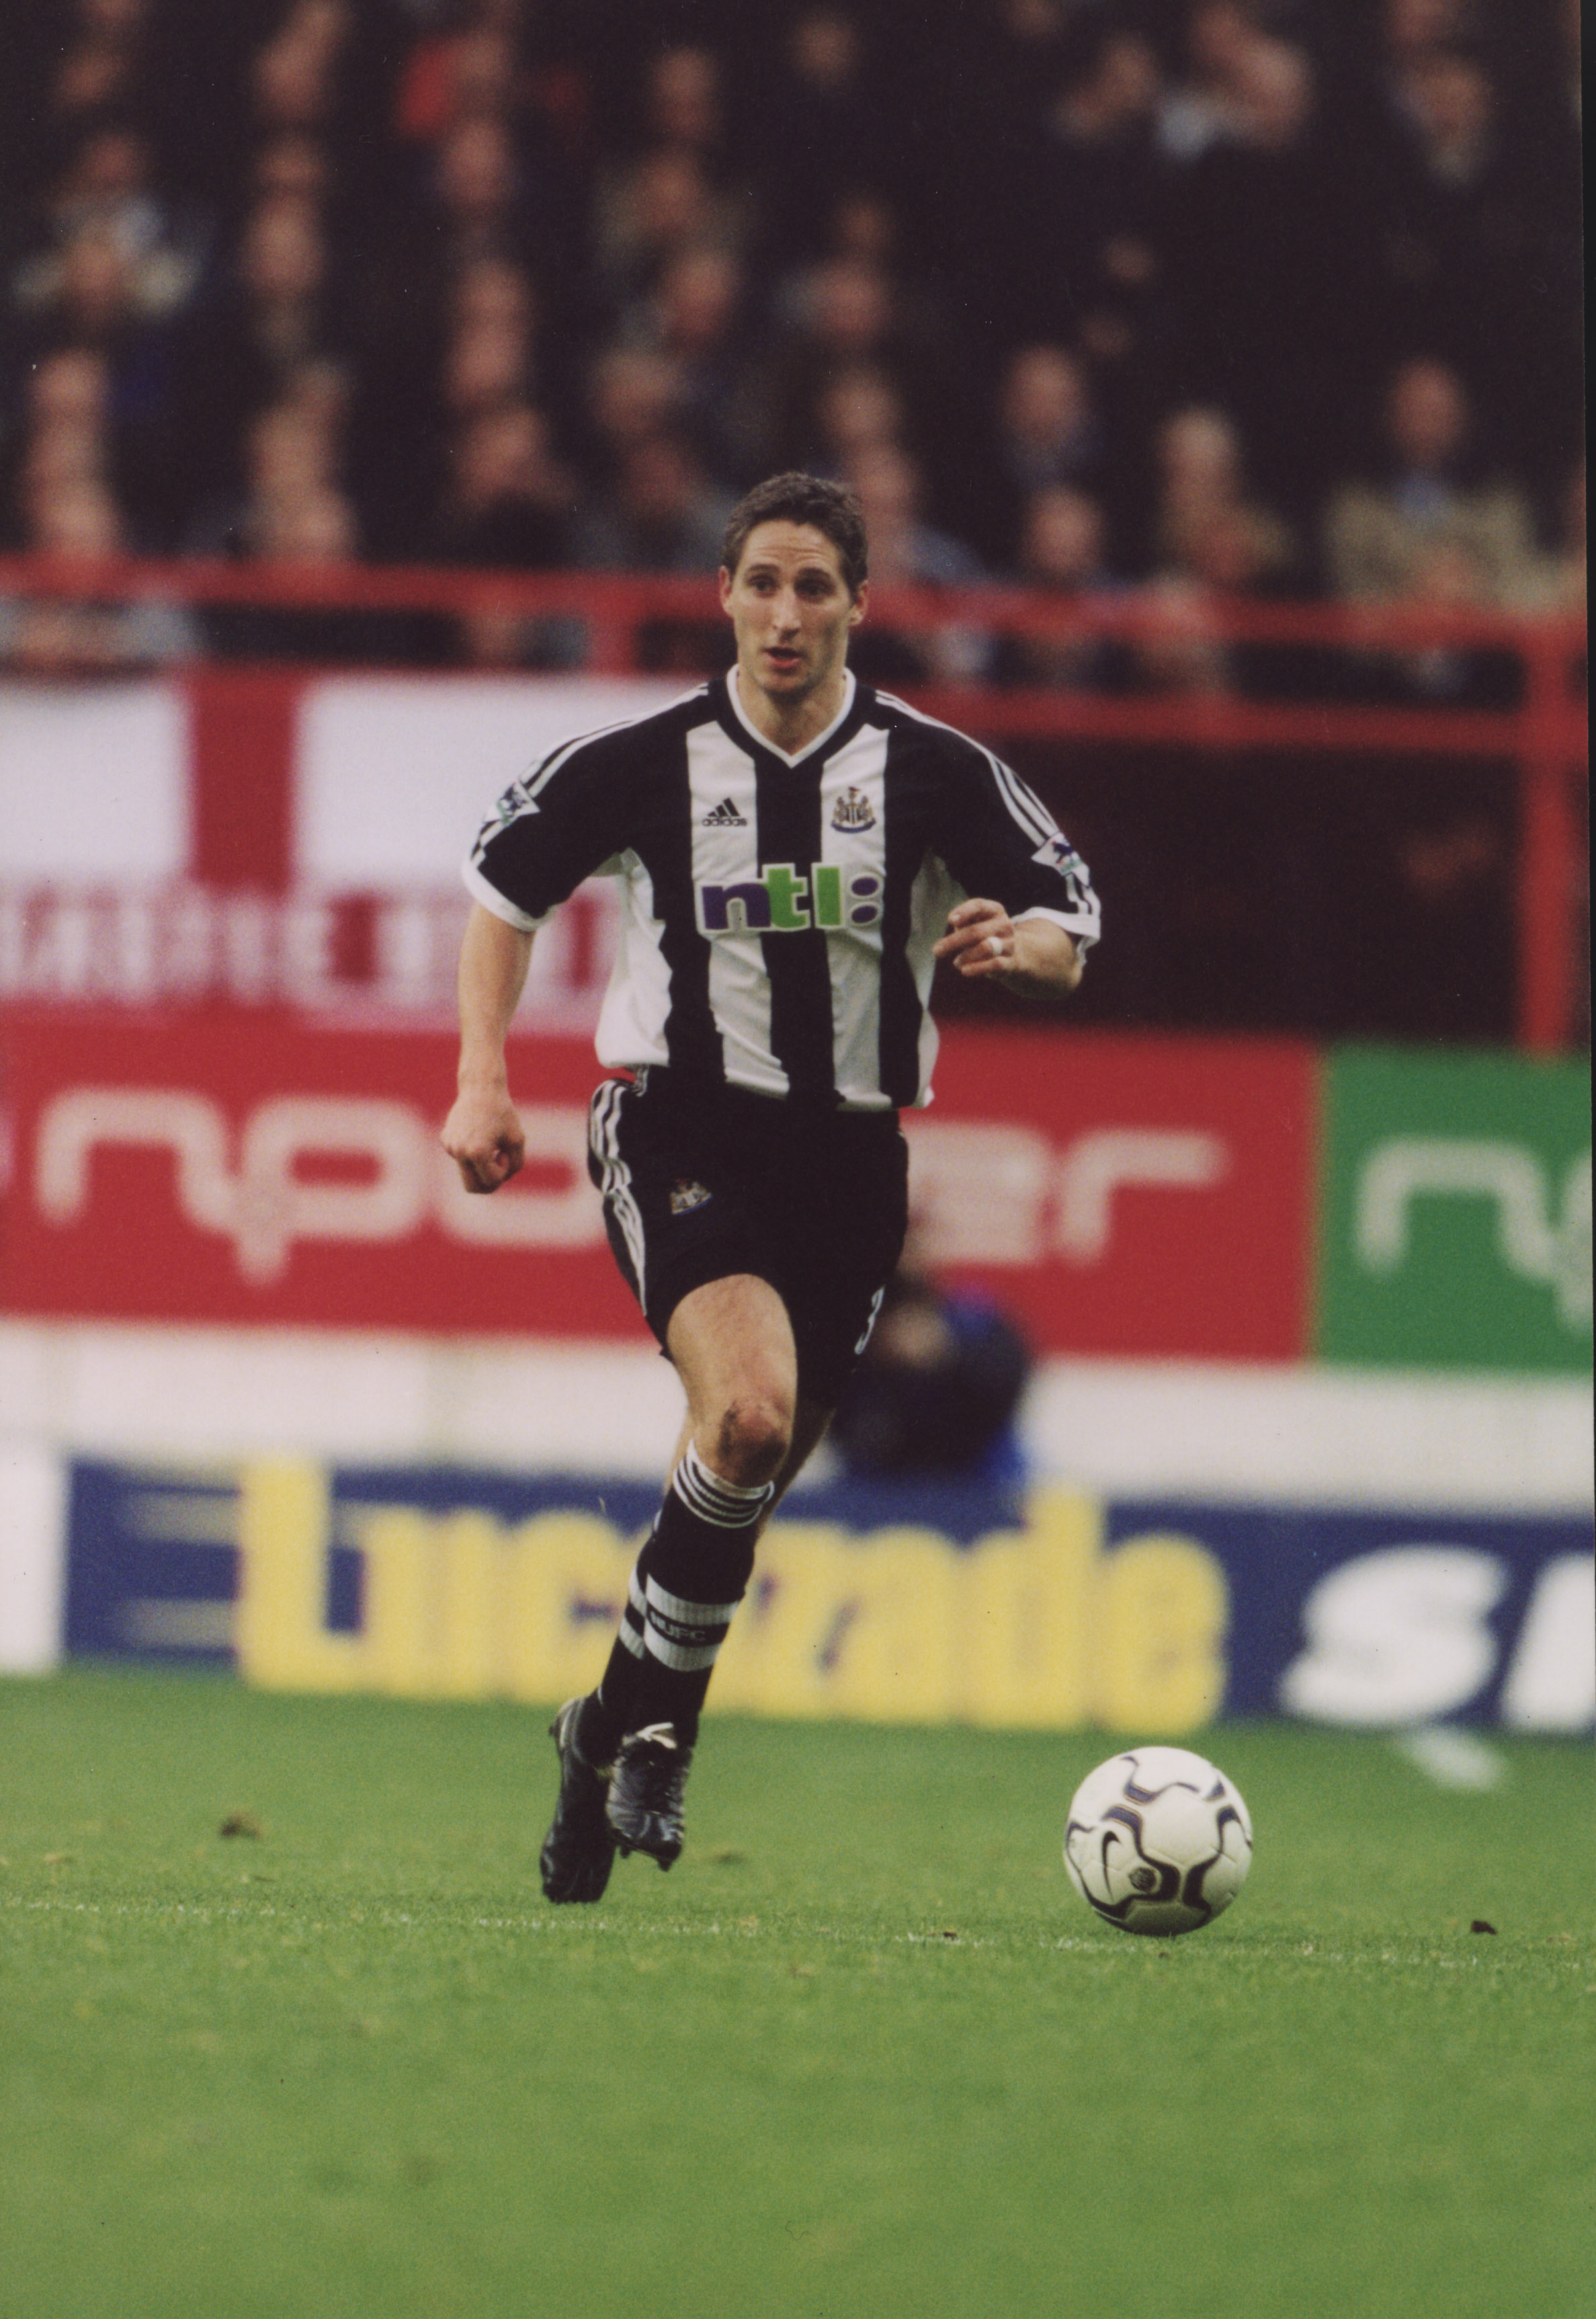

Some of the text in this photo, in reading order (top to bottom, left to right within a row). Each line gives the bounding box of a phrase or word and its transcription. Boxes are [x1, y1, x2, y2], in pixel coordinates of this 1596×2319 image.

[702, 817, 747, 827] adidas
[39, 1084, 1228, 1285] npoer
[235, 1451, 1230, 1738] Luczade
